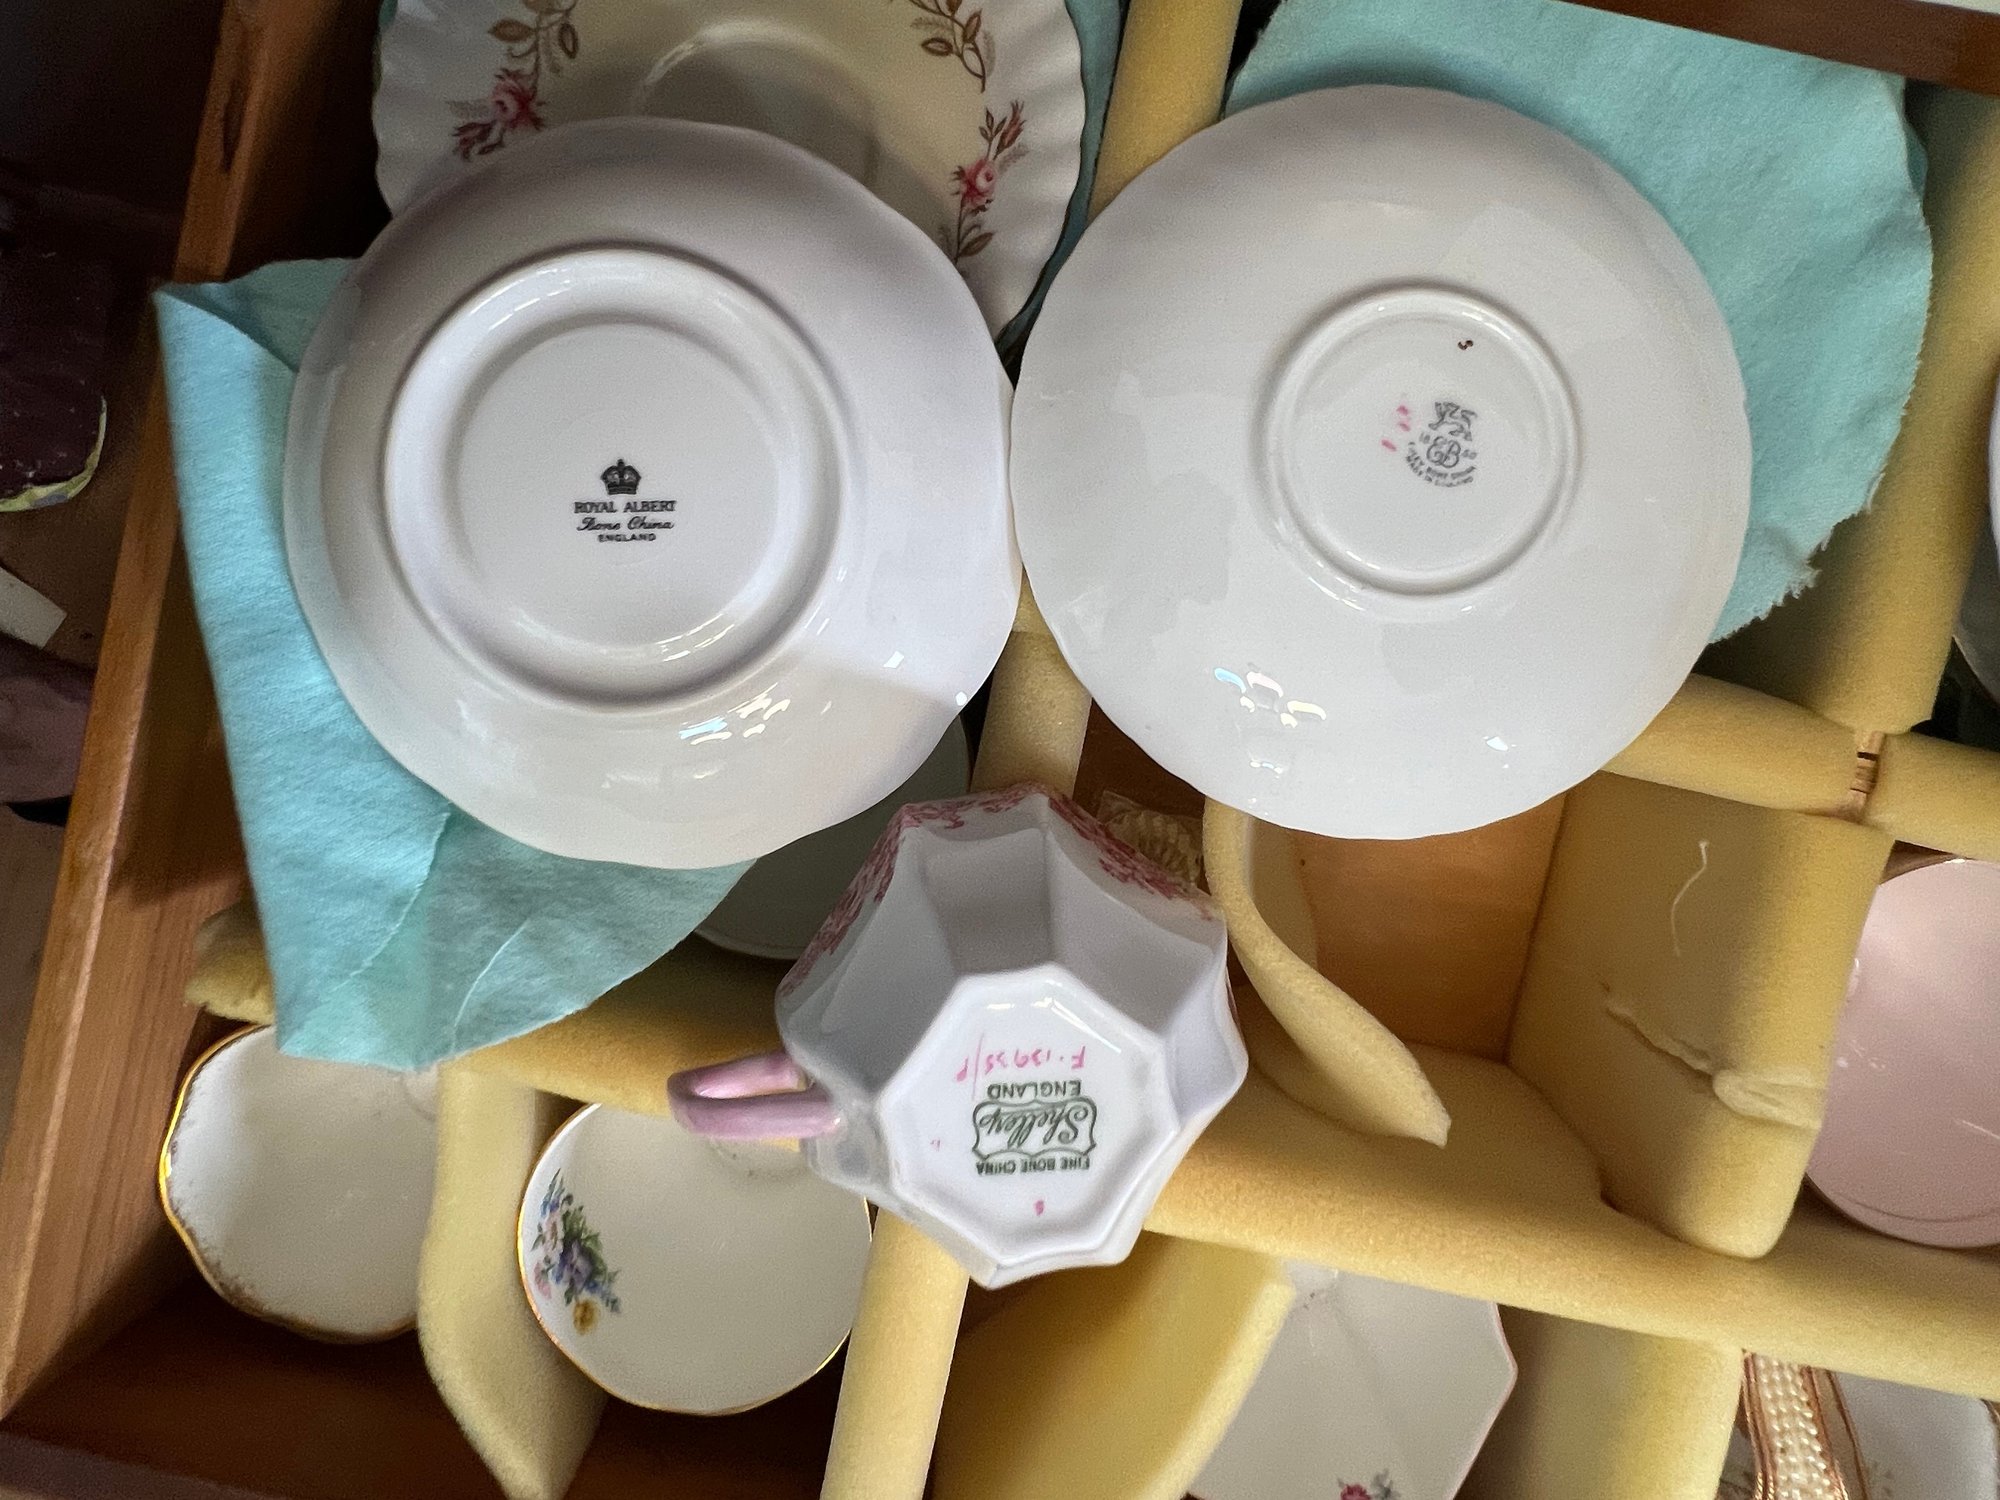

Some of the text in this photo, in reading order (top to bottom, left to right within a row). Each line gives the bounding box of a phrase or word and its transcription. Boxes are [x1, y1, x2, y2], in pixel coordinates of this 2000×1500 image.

[574, 500, 677, 514] ROYAL ALBERT
[576, 516, 675, 531] Bone China
[597, 533, 657, 542] ENGLAND
[986, 1079, 1082, 1099] ENGLAND
[979, 1103, 1089, 1149] Shelley
[975, 1155, 1091, 1176] FINE BONE CHINA
